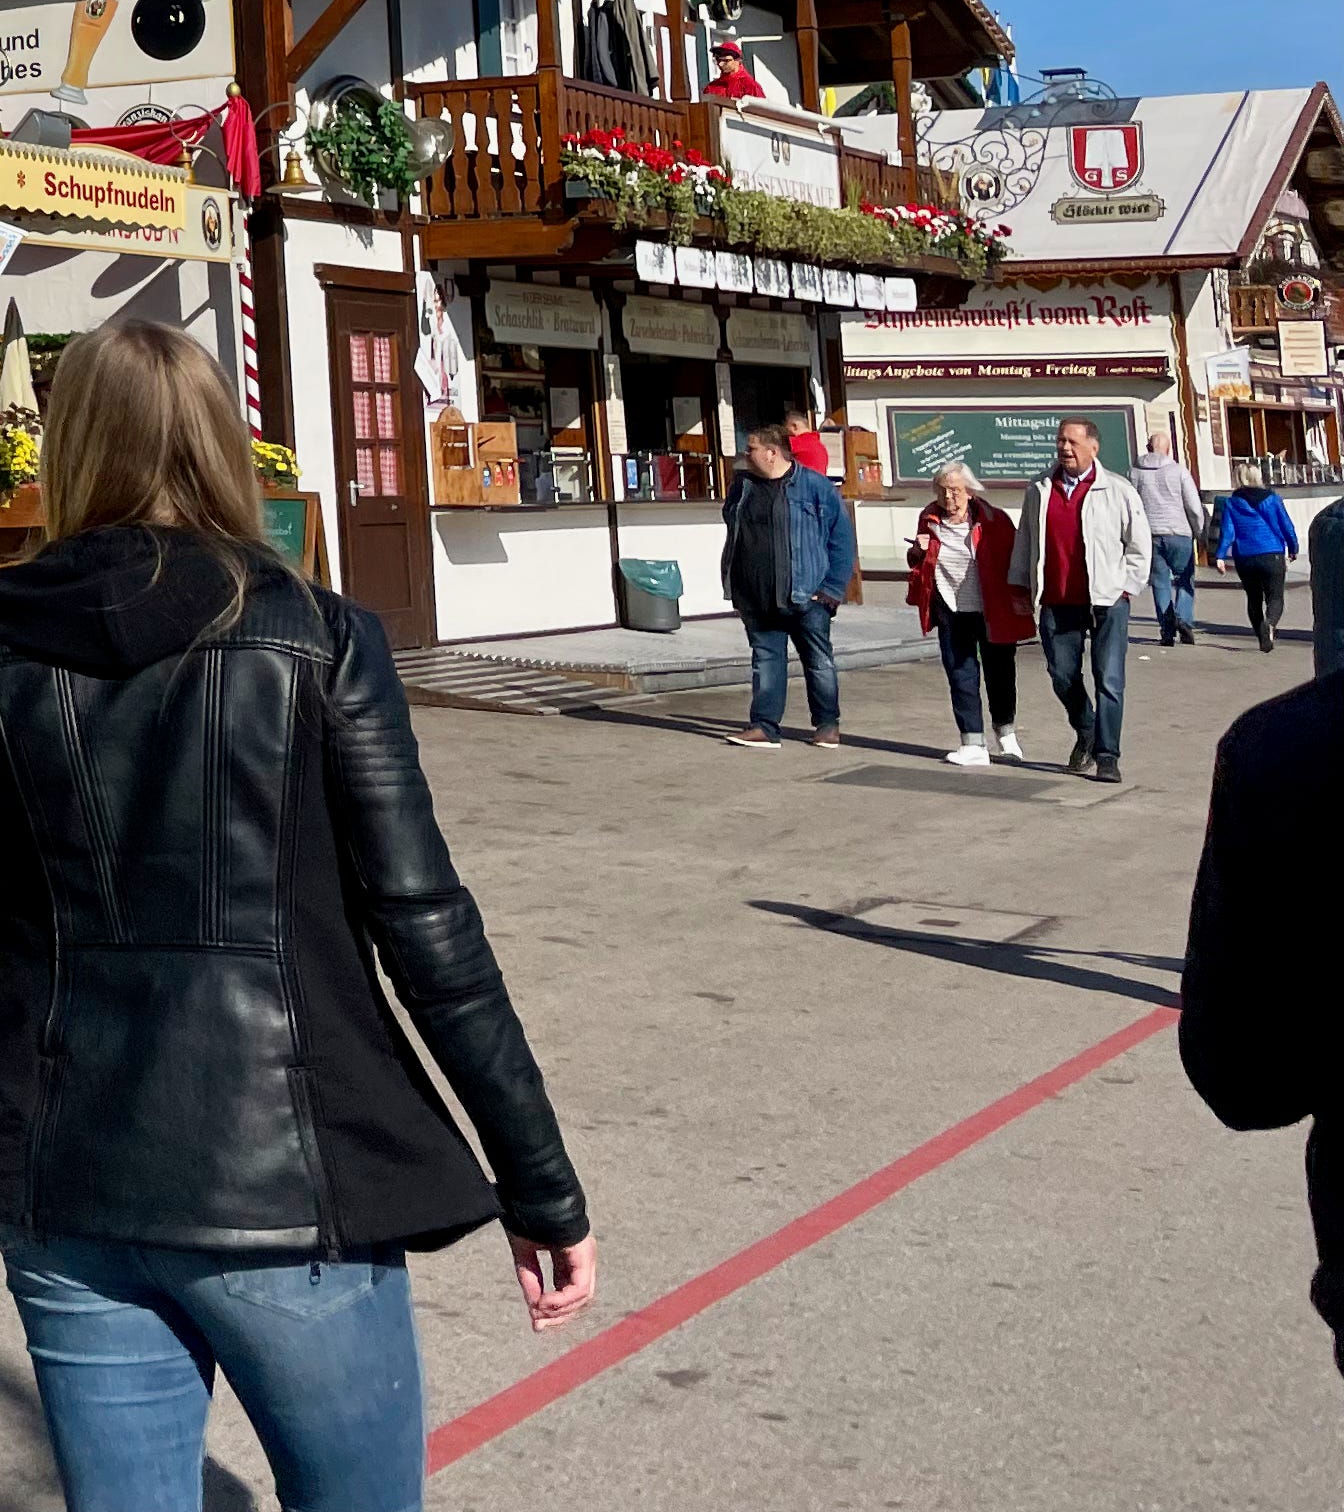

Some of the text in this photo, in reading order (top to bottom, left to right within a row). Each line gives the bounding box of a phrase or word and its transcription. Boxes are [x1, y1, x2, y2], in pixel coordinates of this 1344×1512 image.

[1085, 170, 1128, 182] G S
[44, 171, 175, 213] Schupfnudeln
[1039, 306, 1091, 326] vom
[883, 365, 945, 379] Angebote
[949, 367, 972, 377] von
[977, 364, 1032, 379] Montag
[1045, 363, 1097, 377] Freitag
